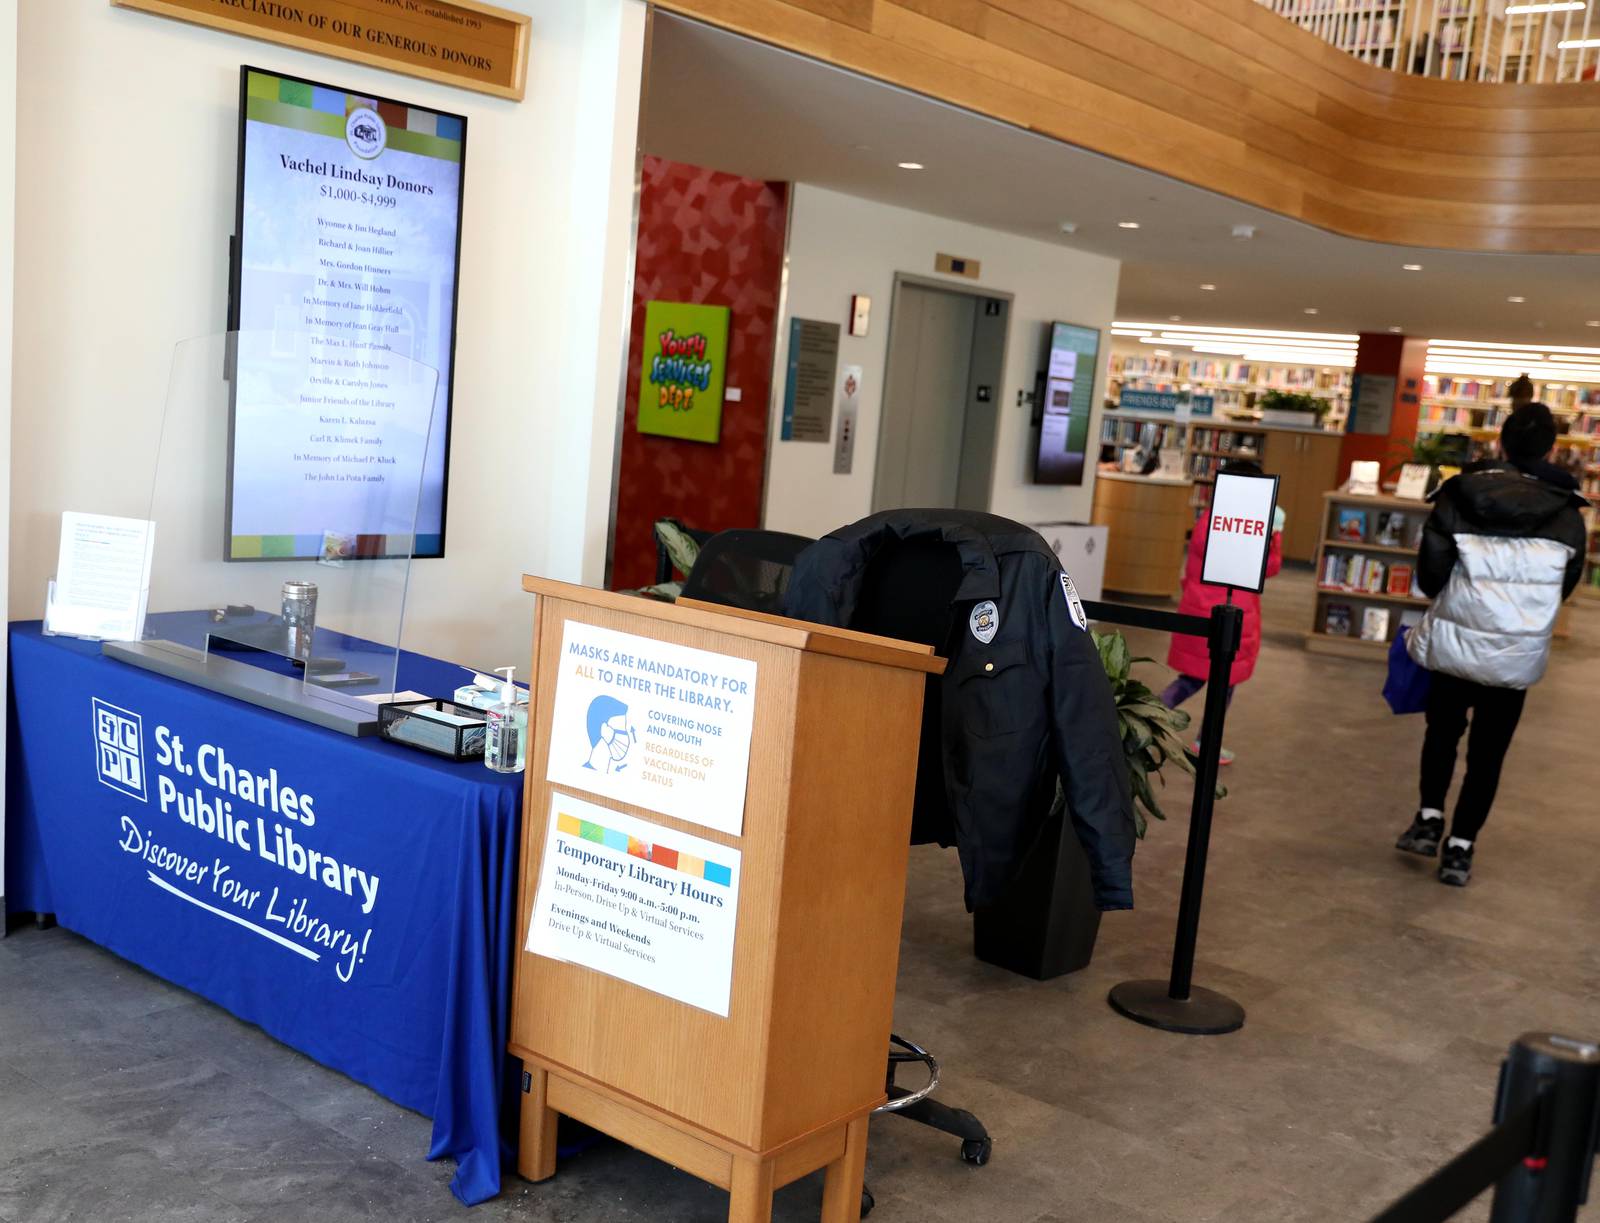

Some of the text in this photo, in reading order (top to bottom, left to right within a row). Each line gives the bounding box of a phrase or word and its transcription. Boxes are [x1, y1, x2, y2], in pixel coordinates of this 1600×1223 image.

[424, 7, 465, 25] established
[209, 0, 492, 71] ECIATION OF OUR GENEROUS DONORS
[280, 153, 434, 196] Vachel Lindsay Donors
[319, 184, 397, 209] $1,000-$4,999
[347, 222, 354, 231] &
[368, 225, 396, 238] Hegland
[318, 238, 346, 250] Richard
[347, 243, 354, 251] &
[319, 258, 335, 269] Mrs.
[336, 260, 363, 272] Gordon
[318, 277, 330, 287] Dr.
[329, 281, 336, 289] &
[337, 280, 352, 290] Mrs.
[303, 296, 311, 305] In
[312, 297, 341, 309] Memory
[342, 301, 351, 309] of
[305, 315, 313, 325] In
[314, 317, 344, 330] Memory
[344, 320, 352, 329] of
[310, 336, 325, 346] The
[310, 356, 335, 366] Marvin
[344, 359, 361, 368] Ruth
[309, 376, 333, 385] Orville
[342, 378, 368, 389] Carolyn
[299, 393, 323, 404] Junior
[323, 395, 350, 405] Friends
[358, 398, 370, 407] the
[371, 399, 396, 409] Library
[319, 415, 340, 425] Karen
[309, 434, 325, 443] Carl
[360, 436, 384, 447] Family
[293, 453, 301, 462] In
[303, 453, 332, 464] Memory
[342, 455, 368, 464] Michael
[304, 472, 318, 481] The
[318, 473, 335, 483] John
[363, 474, 386, 484] Family
[1211, 515, 1265, 537] ENTER
[569, 642, 748, 695] MASKS ARE MANDATORY FOR
[575, 664, 734, 714] ALL TO ENTER THE LIBRARY.
[648, 709, 723, 737] COVERING NOSE
[646, 724, 702, 747] AND MOUTH
[645, 742, 715, 768] REGARDLESS OF
[155, 725, 315, 827] St. Charles
[641, 771, 673, 788] STATUS
[643, 756, 706, 781] VACCINATION
[158, 774, 379, 914] Public Library
[556, 838, 724, 908] Temporary Library Hours
[119, 815, 372, 983] Discover Your Library!
[556, 866, 619, 897] Monday-Friday
[620, 888, 638, 902] 9:00
[679, 911, 701, 924] p.m.
[554, 880, 704, 941] In-Person, Drive Up & Virtual Services
[550, 902, 651, 946] Evenings and Weekends
[548, 917, 656, 964] Drive Up & Virtual Services
